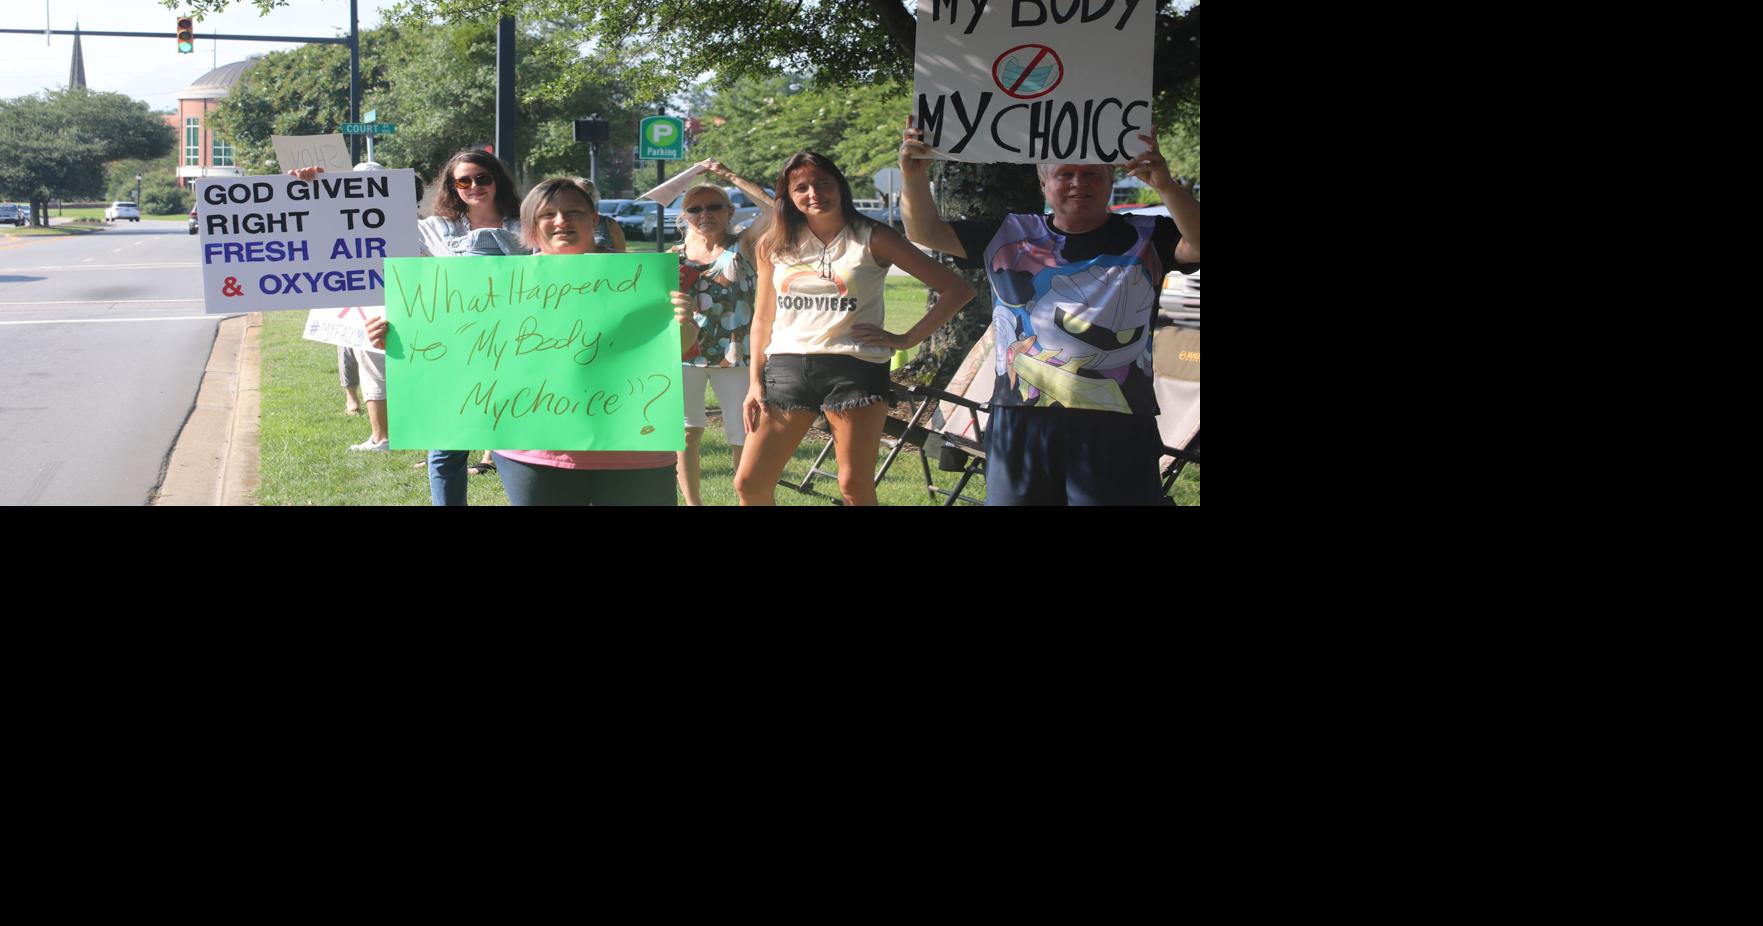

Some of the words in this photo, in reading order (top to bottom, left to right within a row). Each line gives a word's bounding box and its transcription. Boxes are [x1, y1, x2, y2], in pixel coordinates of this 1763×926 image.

[932, 0, 988, 34] MY
[1011, 0, 1139, 31] BODY
[346, 124, 378, 133] COURT
[653, 124, 673, 143] P
[917, 91, 993, 154] MY
[990, 98, 1149, 163] CHOICE
[647, 147, 677, 157] Parking
[204, 182, 274, 206] GOD
[286, 176, 390, 201] GIVEN
[206, 211, 310, 236] RIGHT
[340, 208, 386, 230] TO
[204, 240, 310, 265] FRESH
[330, 237, 387, 260] AIR
[222, 276, 245, 298] &
[259, 269, 386, 295] OXYGEN
[392, 264, 500, 323] What
[508, 264, 643, 310] Happend
[777, 295, 814, 311] GOOD
[815, 296, 858, 312] VIBES
